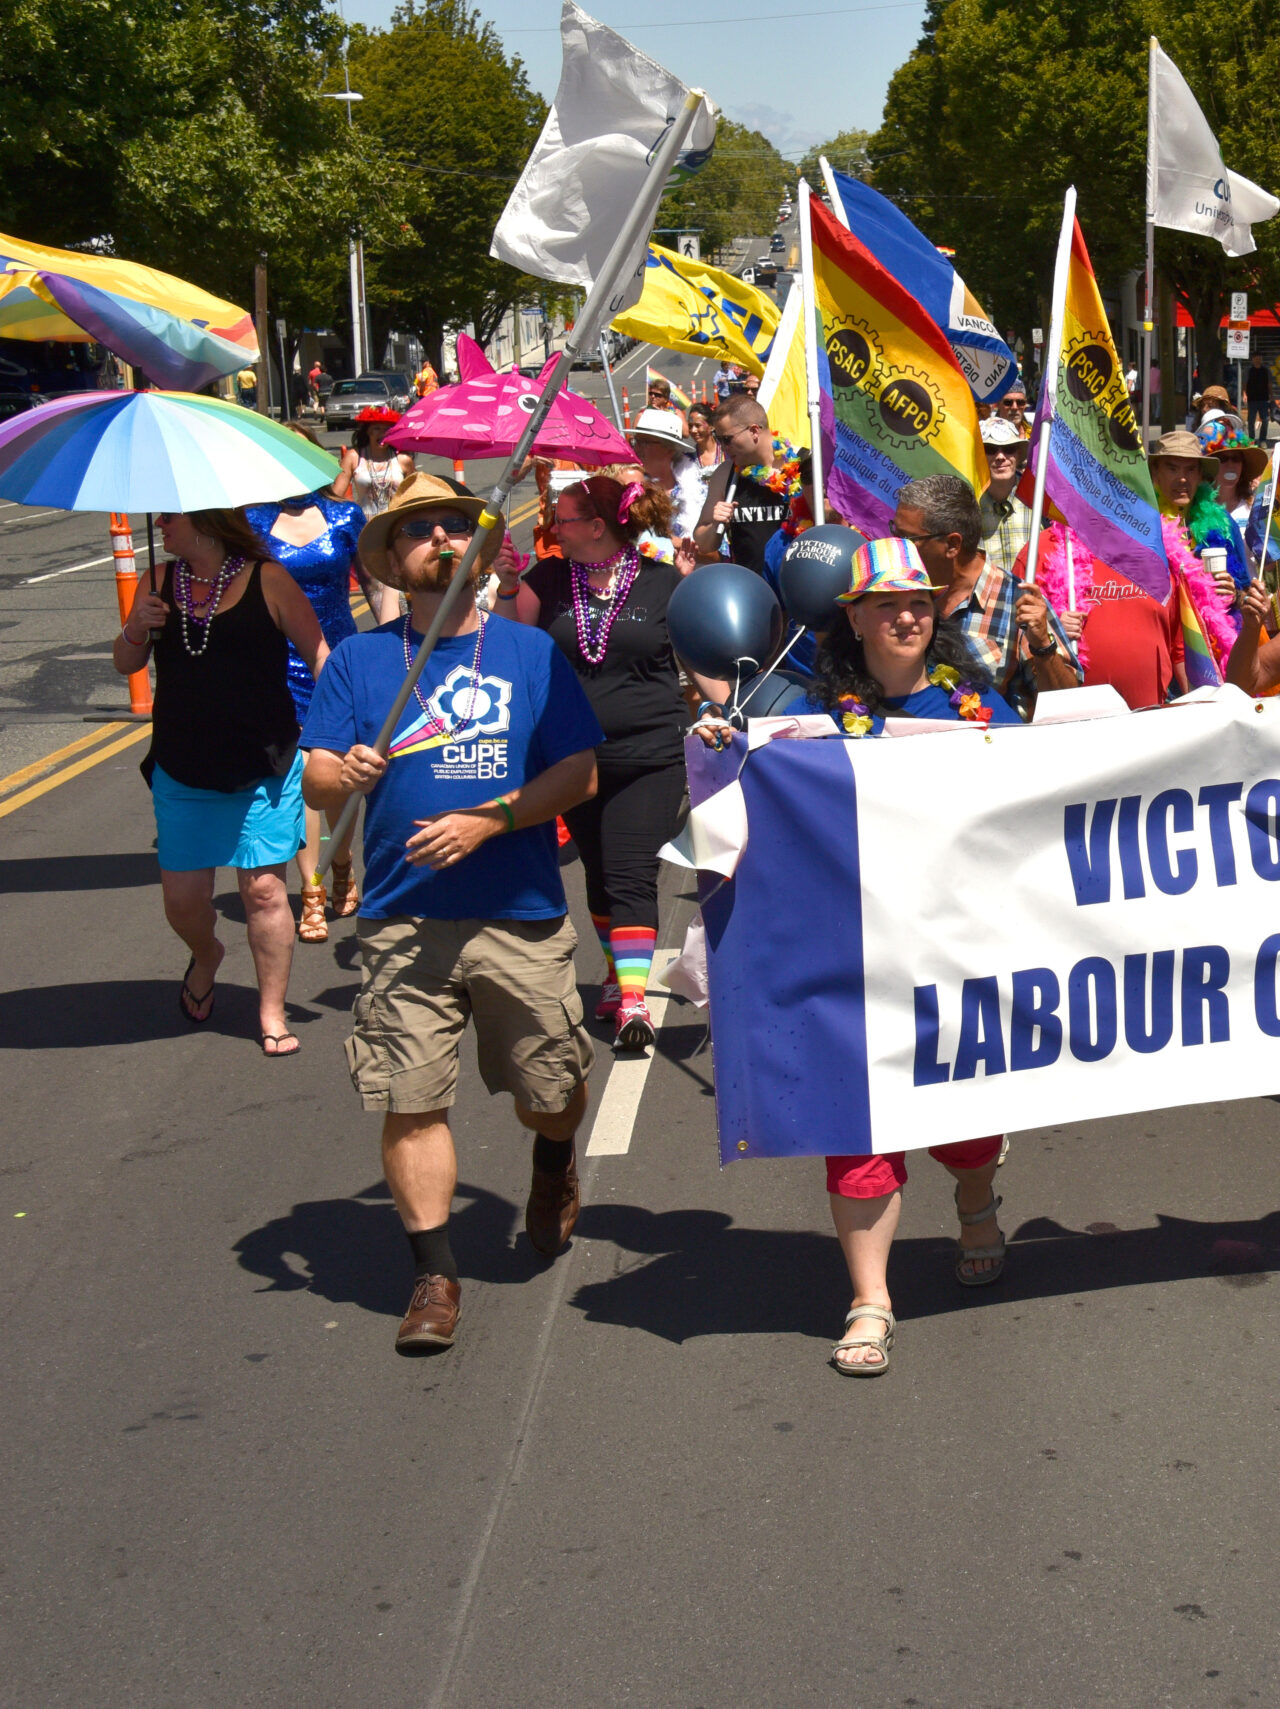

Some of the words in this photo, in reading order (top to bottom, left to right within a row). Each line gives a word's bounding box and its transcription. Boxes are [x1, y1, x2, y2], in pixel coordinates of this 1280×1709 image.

[827, 338, 866, 379] PSAC
[1070, 352, 1106, 394] PSAC
[882, 388, 929, 431] AFPC
[838, 448, 879, 483] publique
[878, 478, 892, 494] du
[881, 455, 913, 485] Canad
[1104, 467, 1138, 504] Canada
[1070, 464, 1102, 499] publique
[1101, 493, 1114, 510] du
[1113, 502, 1151, 537] Canada
[796, 551, 836, 567] COUNCIL
[800, 540, 842, 556] VICTORIA
[800, 545, 838, 560] LABOUR
[442, 744, 508, 763] CUPE
[477, 762, 508, 779] BC
[913, 945, 1230, 1087] LABOUR
